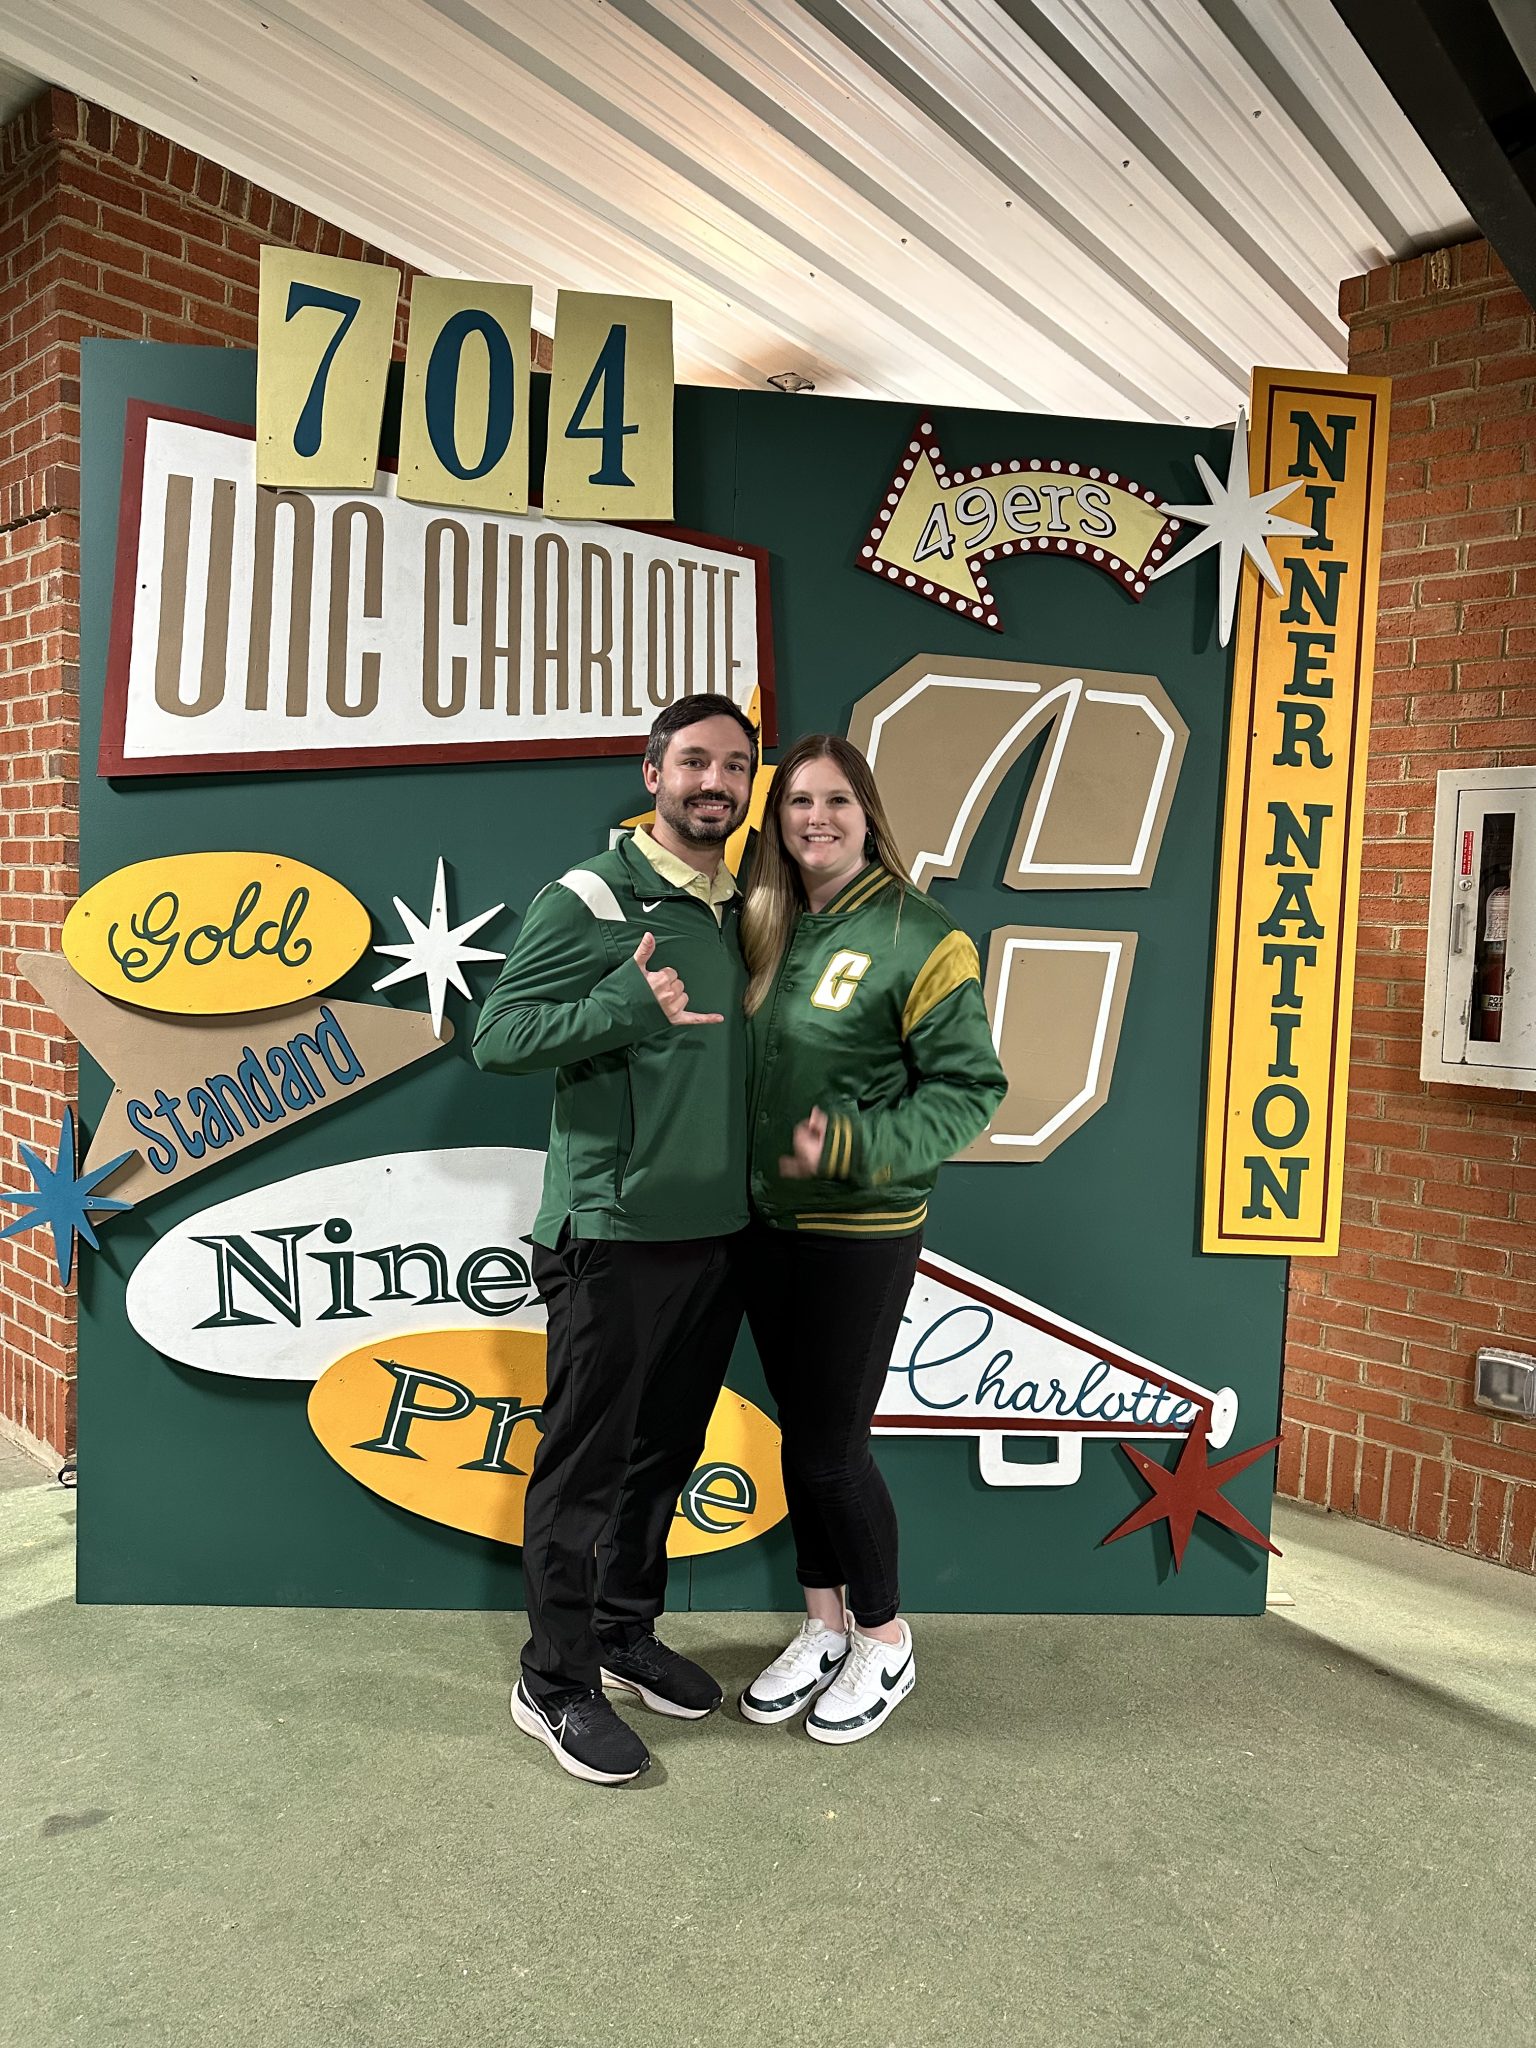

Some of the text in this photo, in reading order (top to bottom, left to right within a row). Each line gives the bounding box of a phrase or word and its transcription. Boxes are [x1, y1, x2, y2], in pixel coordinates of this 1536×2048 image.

[284, 281, 639, 487] 704
[912, 483, 1117, 563] 49ers
[423, 518, 742, 717] CHARLOTTE
[1241, 410, 1357, 1220] NINER NATION
[107, 881, 313, 983] Gold
[126, 1004, 365, 1176] Standard
[188, 1217, 547, 1329] Nine
[350, 1358, 757, 1534] Pre
[888, 1305, 1196, 1430] Charlotte
